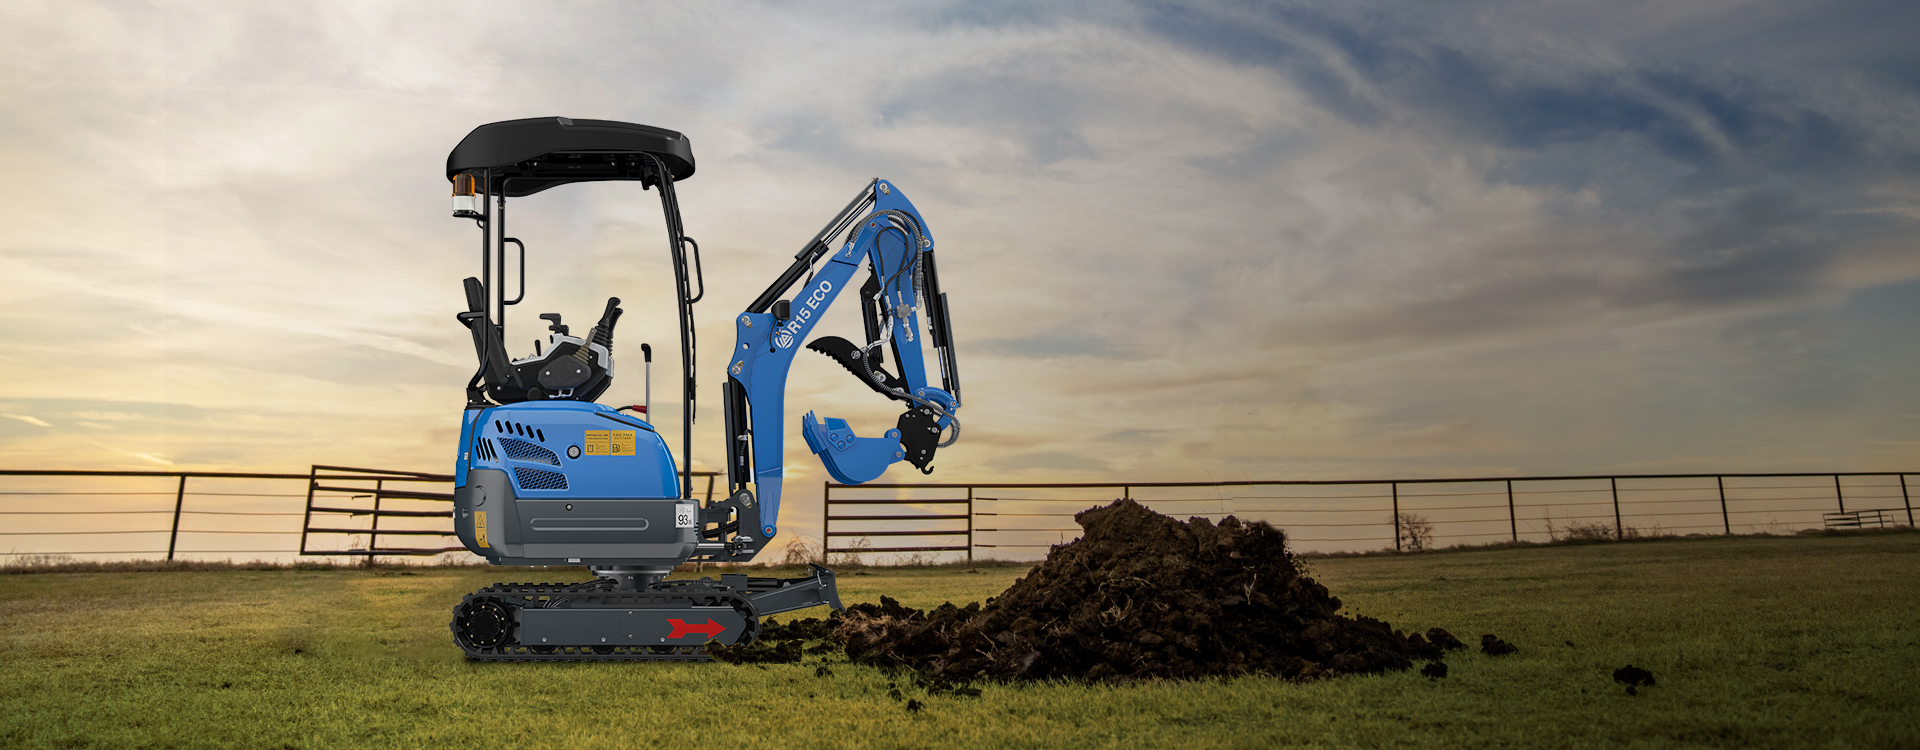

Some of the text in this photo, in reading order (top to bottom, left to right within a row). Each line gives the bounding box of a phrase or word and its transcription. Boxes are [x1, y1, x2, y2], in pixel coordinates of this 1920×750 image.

[787, 280, 832, 334] R15 ECO
[678, 514, 688, 525] 93
